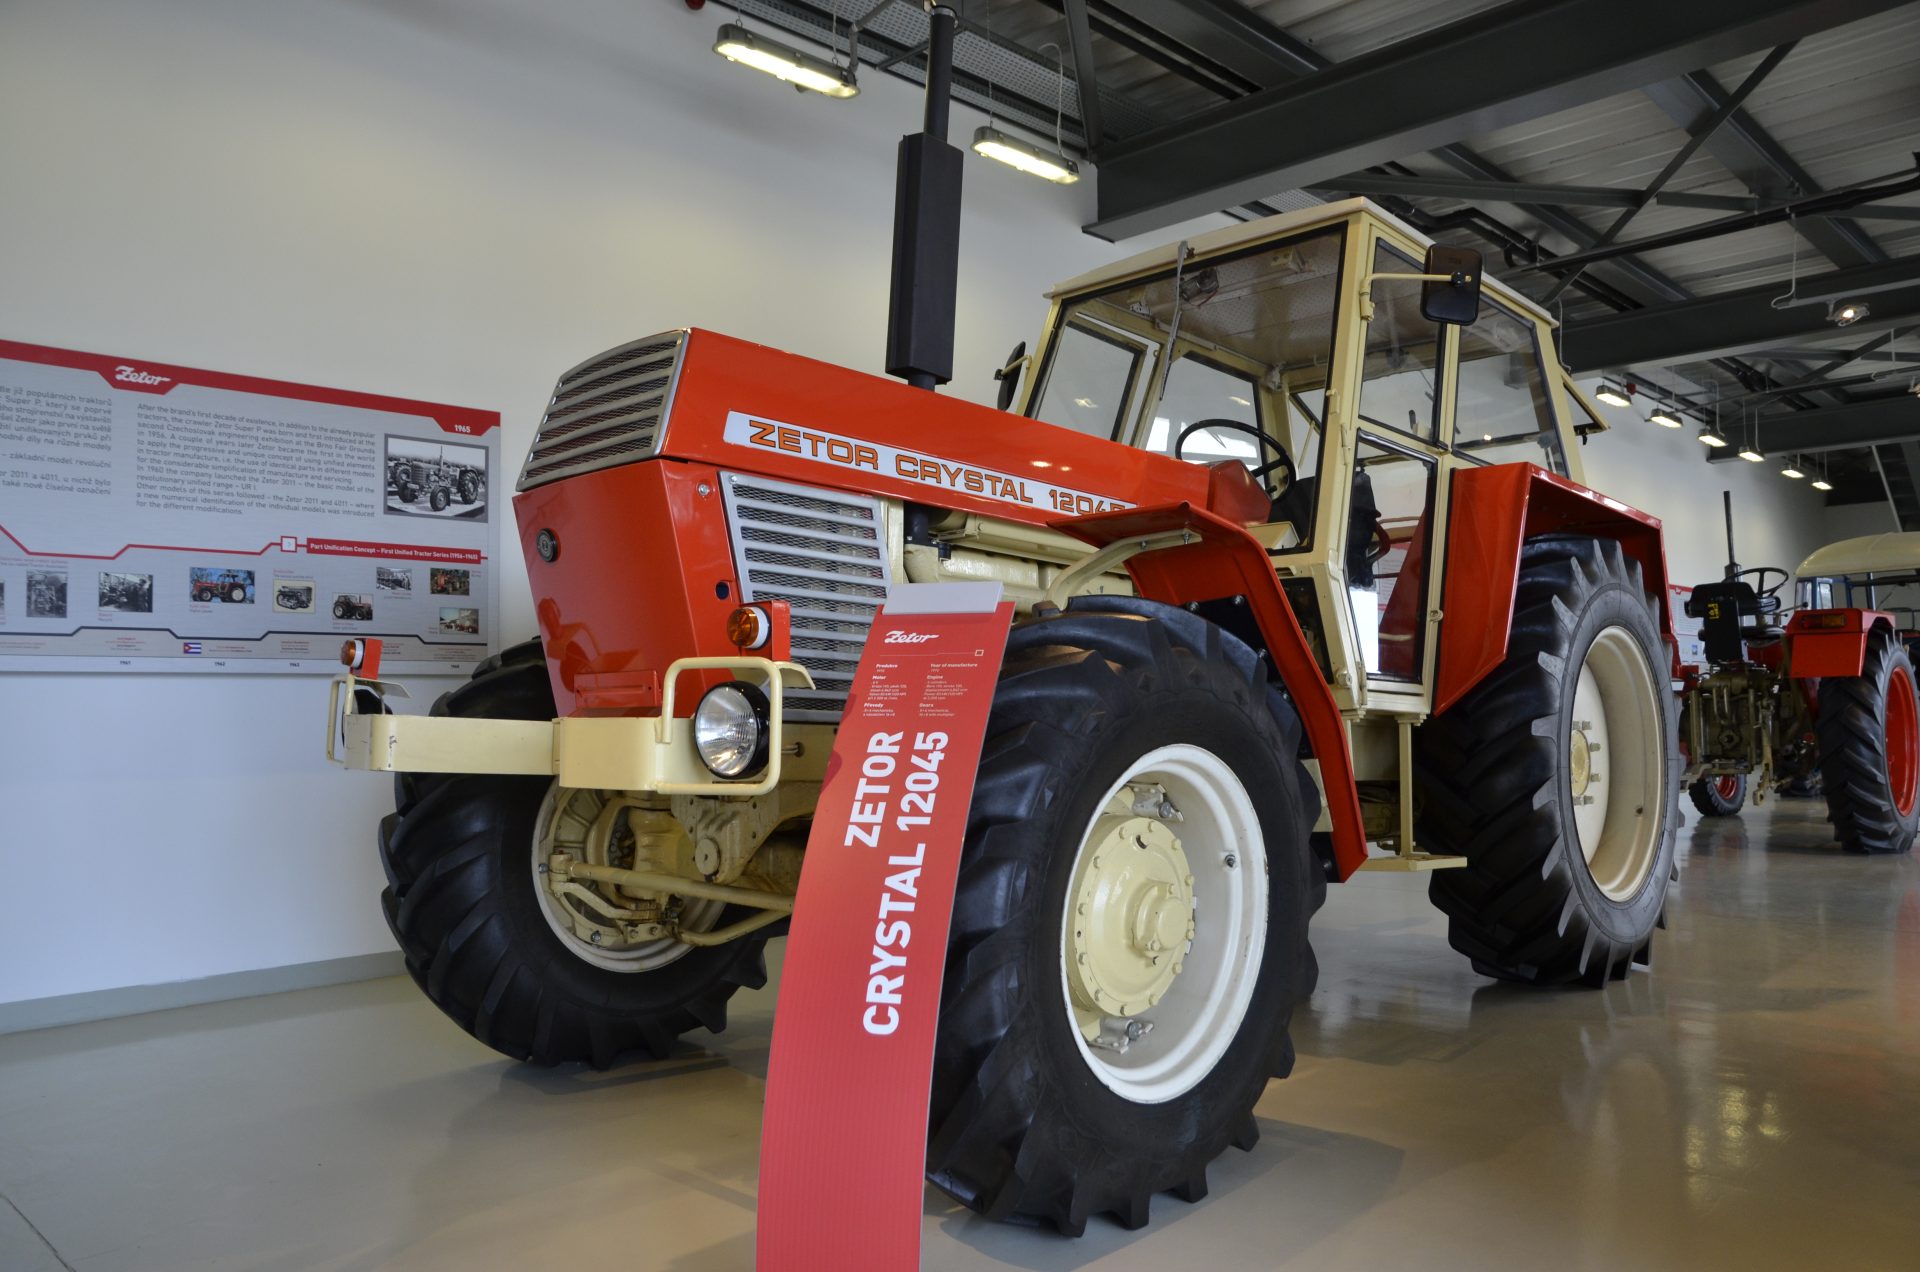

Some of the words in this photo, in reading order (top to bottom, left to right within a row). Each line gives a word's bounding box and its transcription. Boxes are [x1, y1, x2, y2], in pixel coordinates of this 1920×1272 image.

[114, 365, 171, 386] Zetor
[454, 424, 471, 433] 1965
[749, 420, 878, 470] ZETOR
[896, 453, 1034, 504] CRYSTAL
[884, 630, 940, 644] Zetor
[844, 732, 904, 848] ZETOR
[863, 844, 926, 1035] CRYSTAL
[896, 732, 948, 832] 12045
